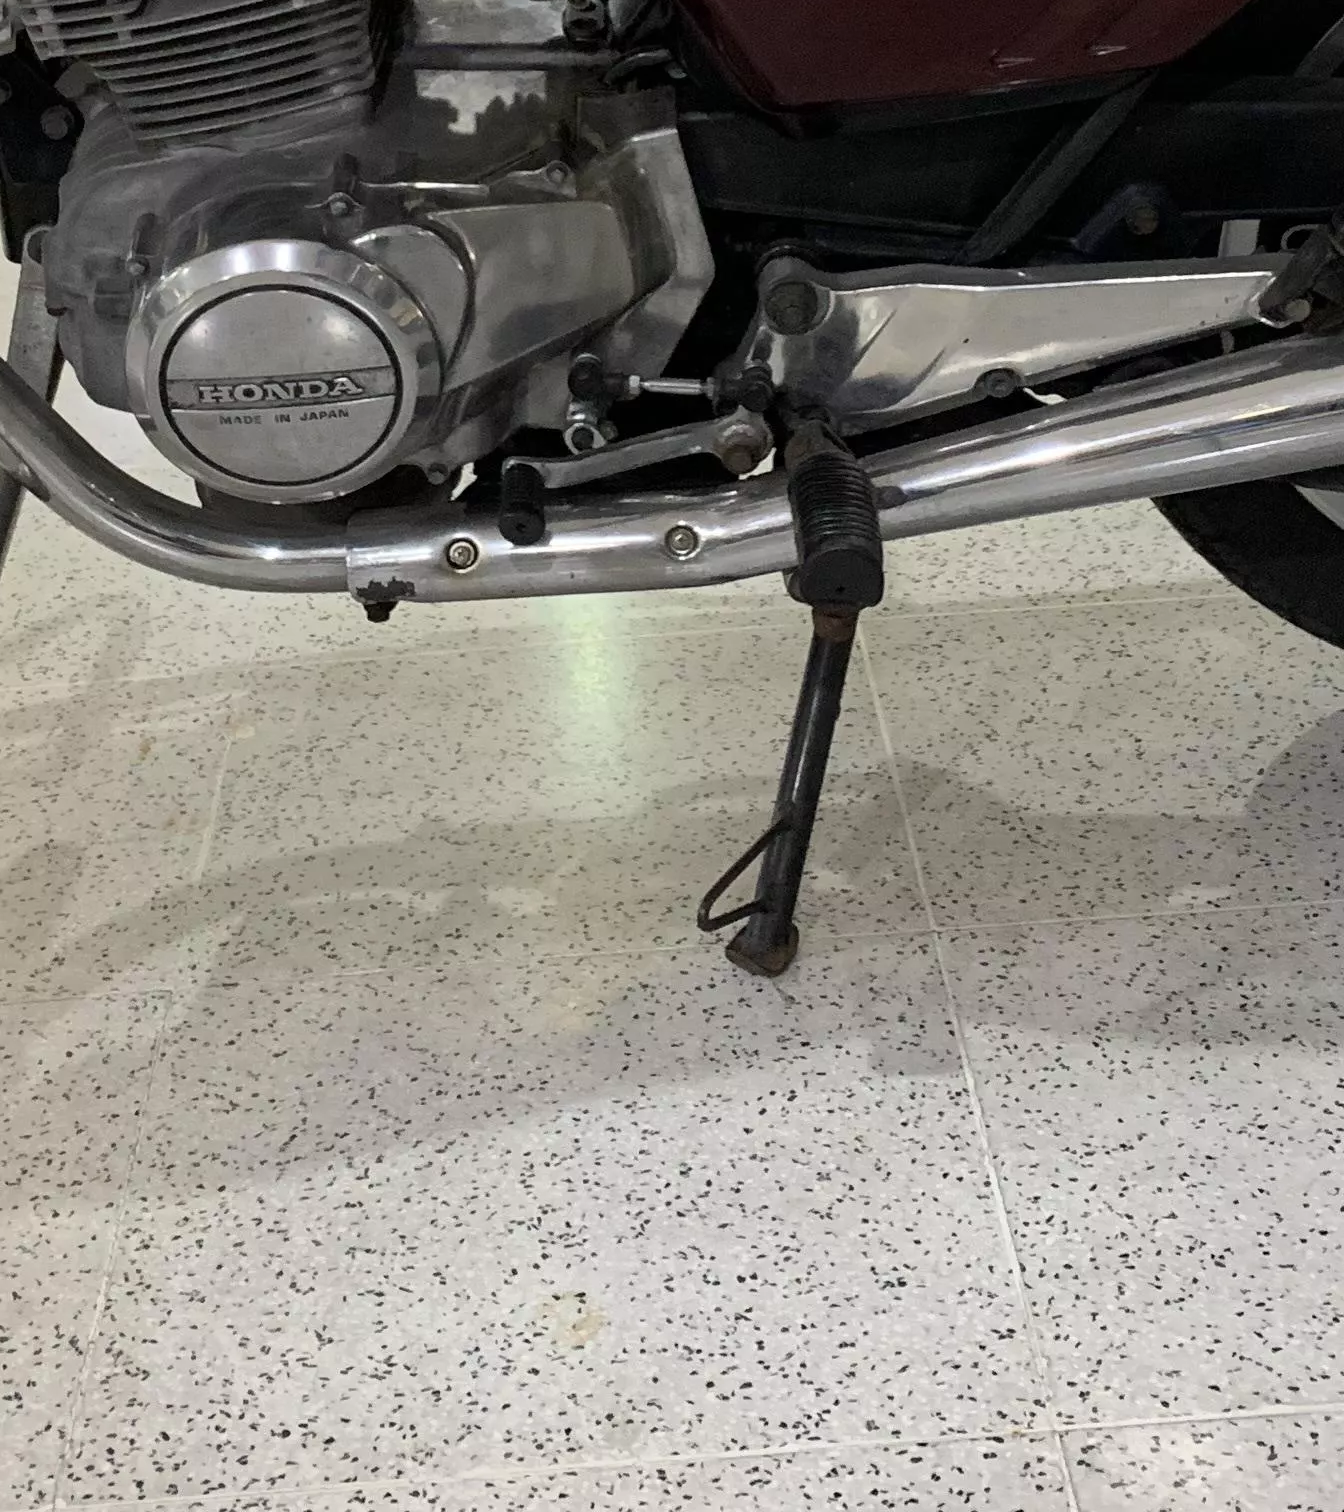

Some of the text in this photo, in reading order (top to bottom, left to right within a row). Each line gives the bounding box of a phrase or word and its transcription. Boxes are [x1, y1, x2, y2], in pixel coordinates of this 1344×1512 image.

[199, 377, 363, 403] HONDA
[219, 408, 349, 426] MADE IN JAPAN
